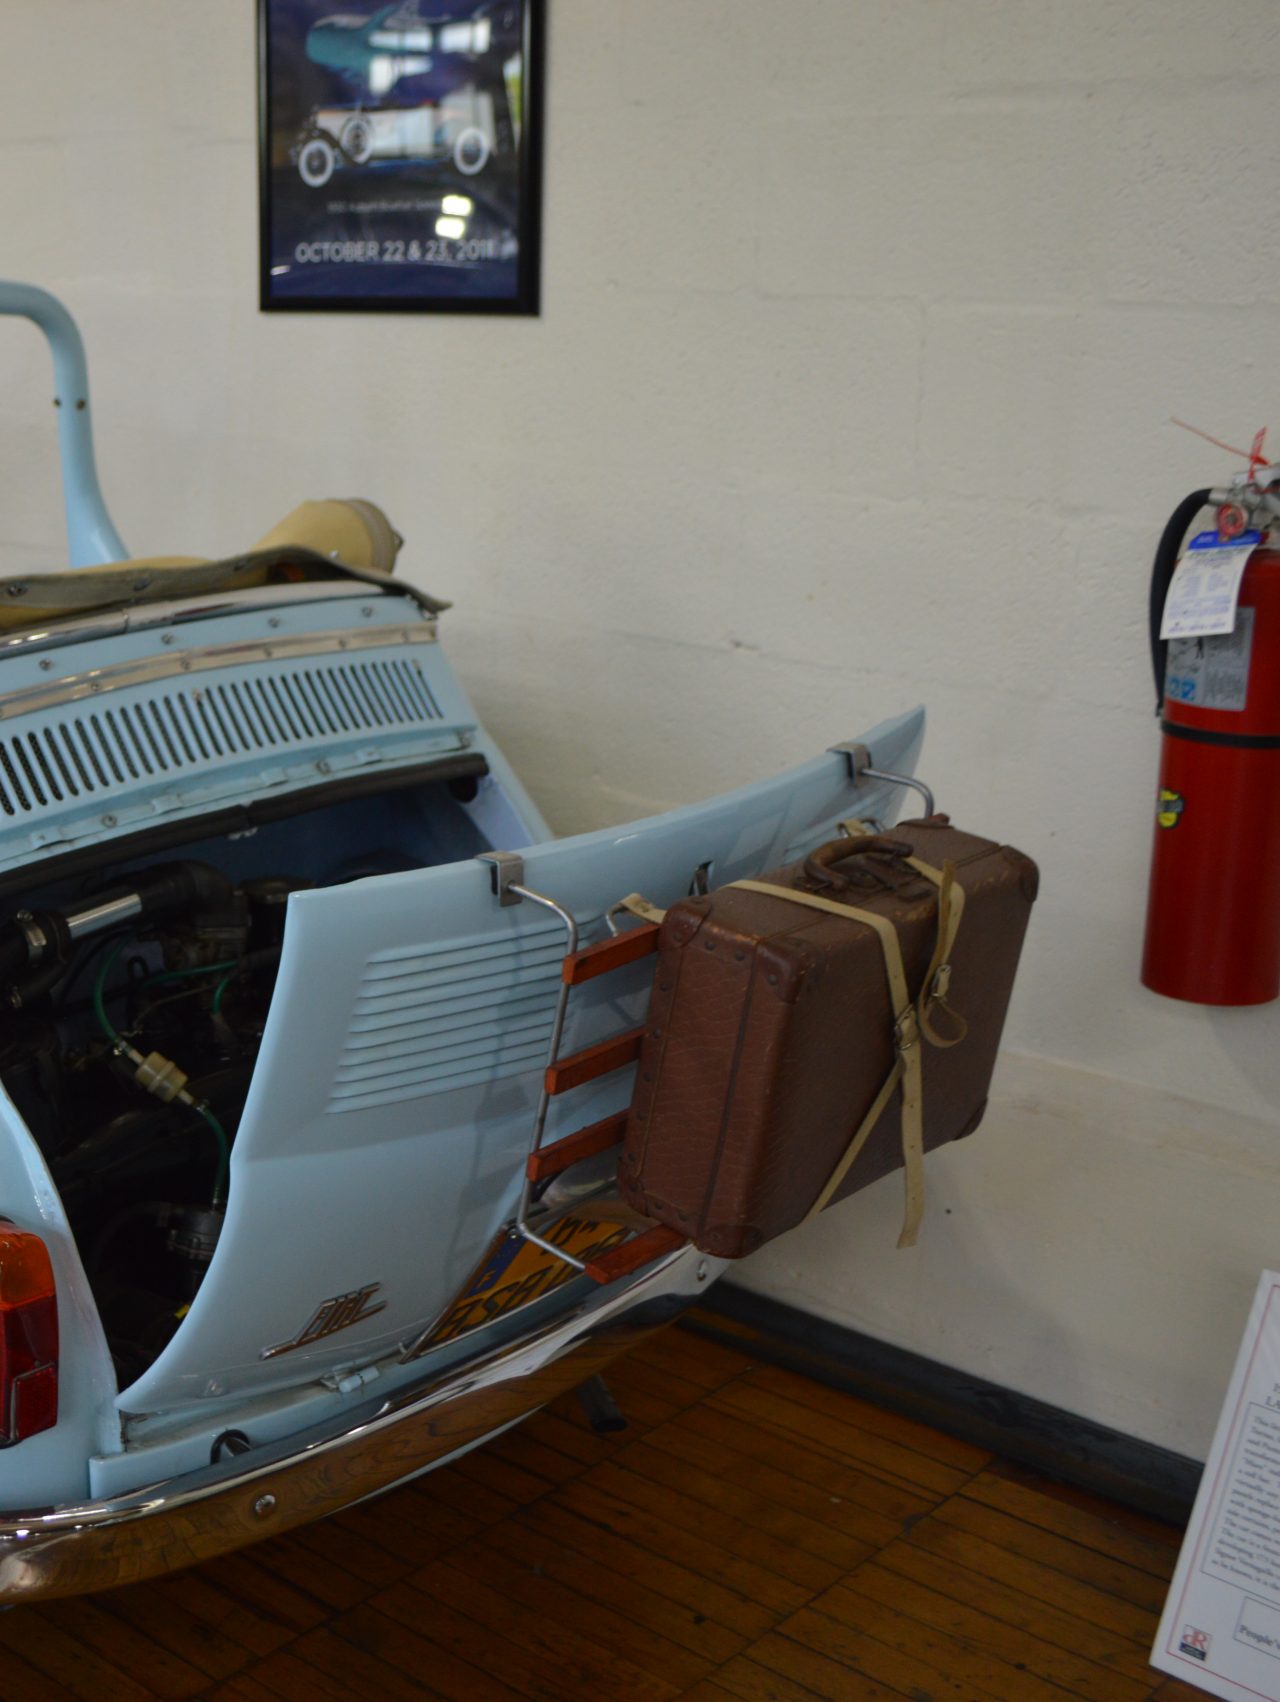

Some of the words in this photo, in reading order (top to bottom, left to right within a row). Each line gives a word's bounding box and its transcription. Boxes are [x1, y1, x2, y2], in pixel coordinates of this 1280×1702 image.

[295, 240, 380, 263] OCTOBER
[383, 239, 405, 262] 22
[407, 239, 421, 262] &
